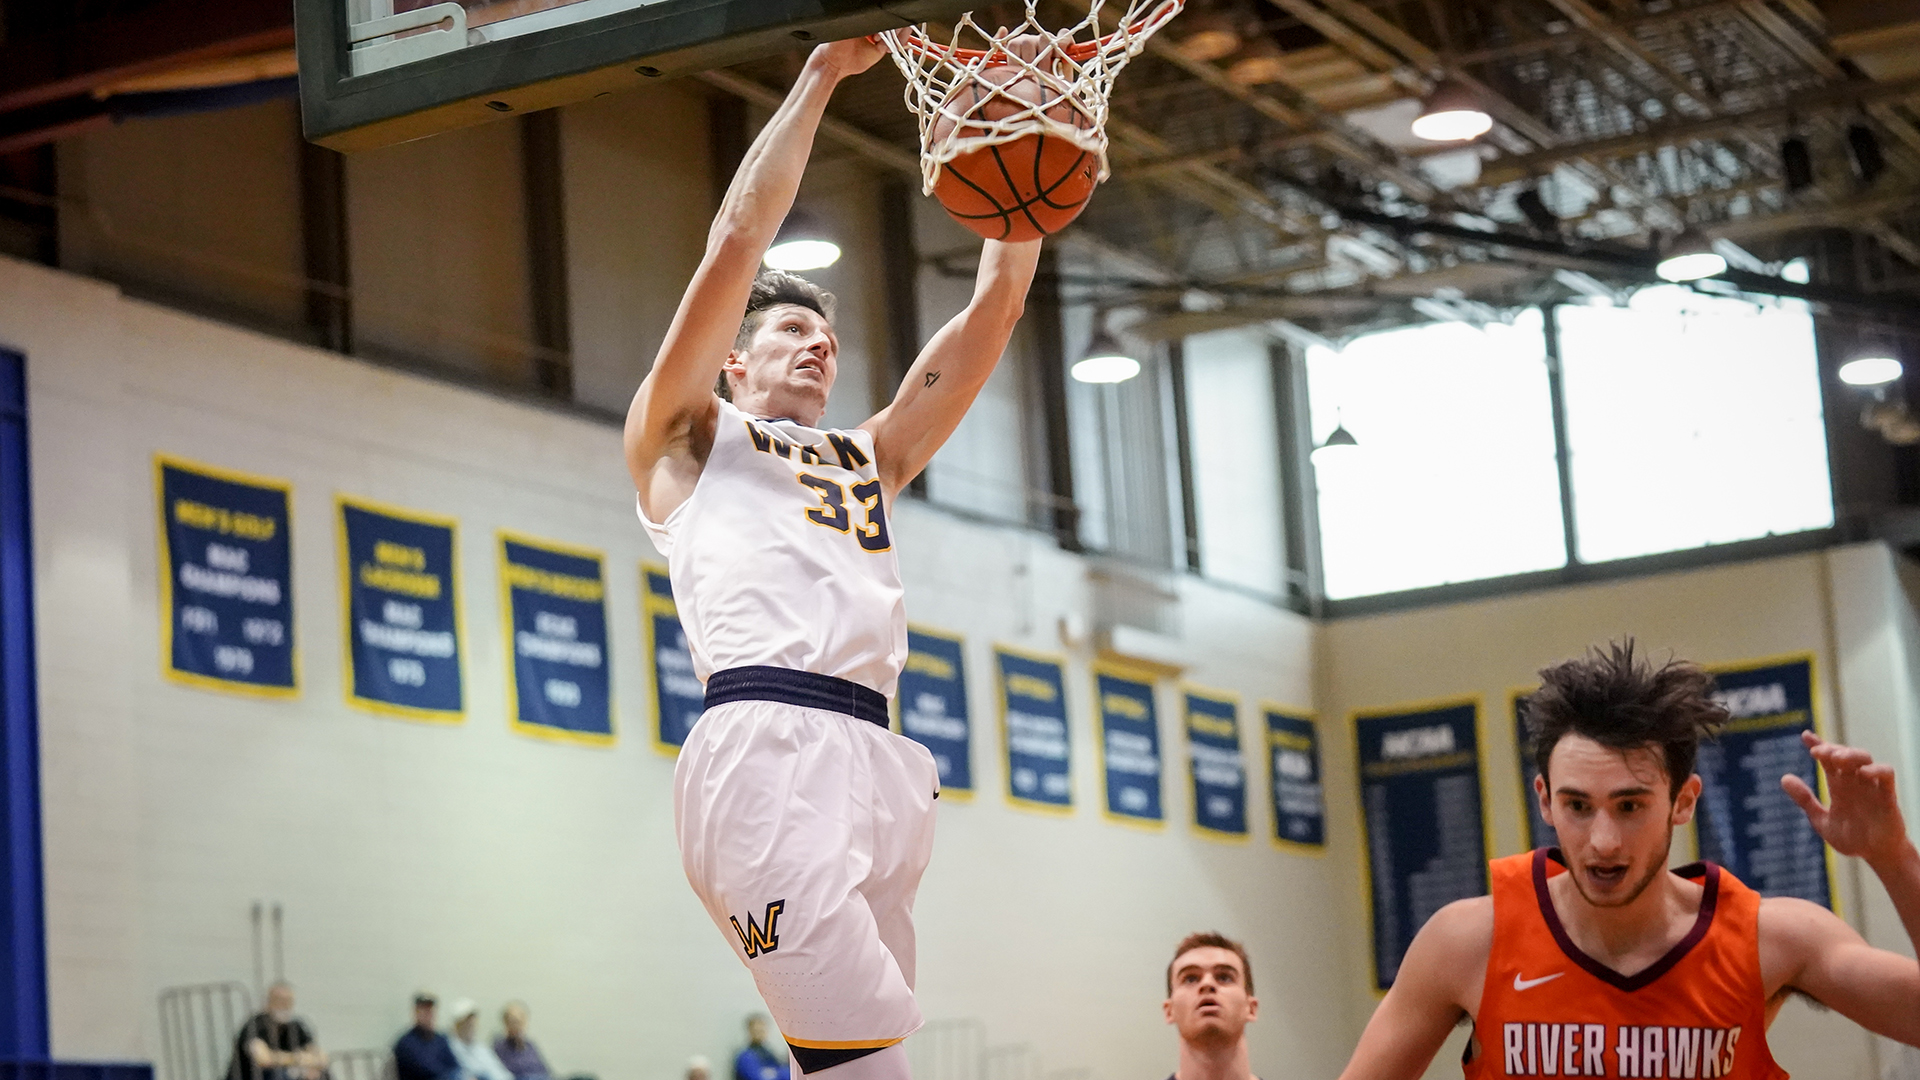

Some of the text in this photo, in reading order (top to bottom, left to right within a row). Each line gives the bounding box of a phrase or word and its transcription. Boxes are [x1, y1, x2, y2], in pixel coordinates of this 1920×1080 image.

[796, 471, 892, 553] 33
[180, 562, 281, 605] CHAMPIONS
[730, 899, 785, 959] W
[1503, 1022, 1742, 1079] RIVER HAWKS
